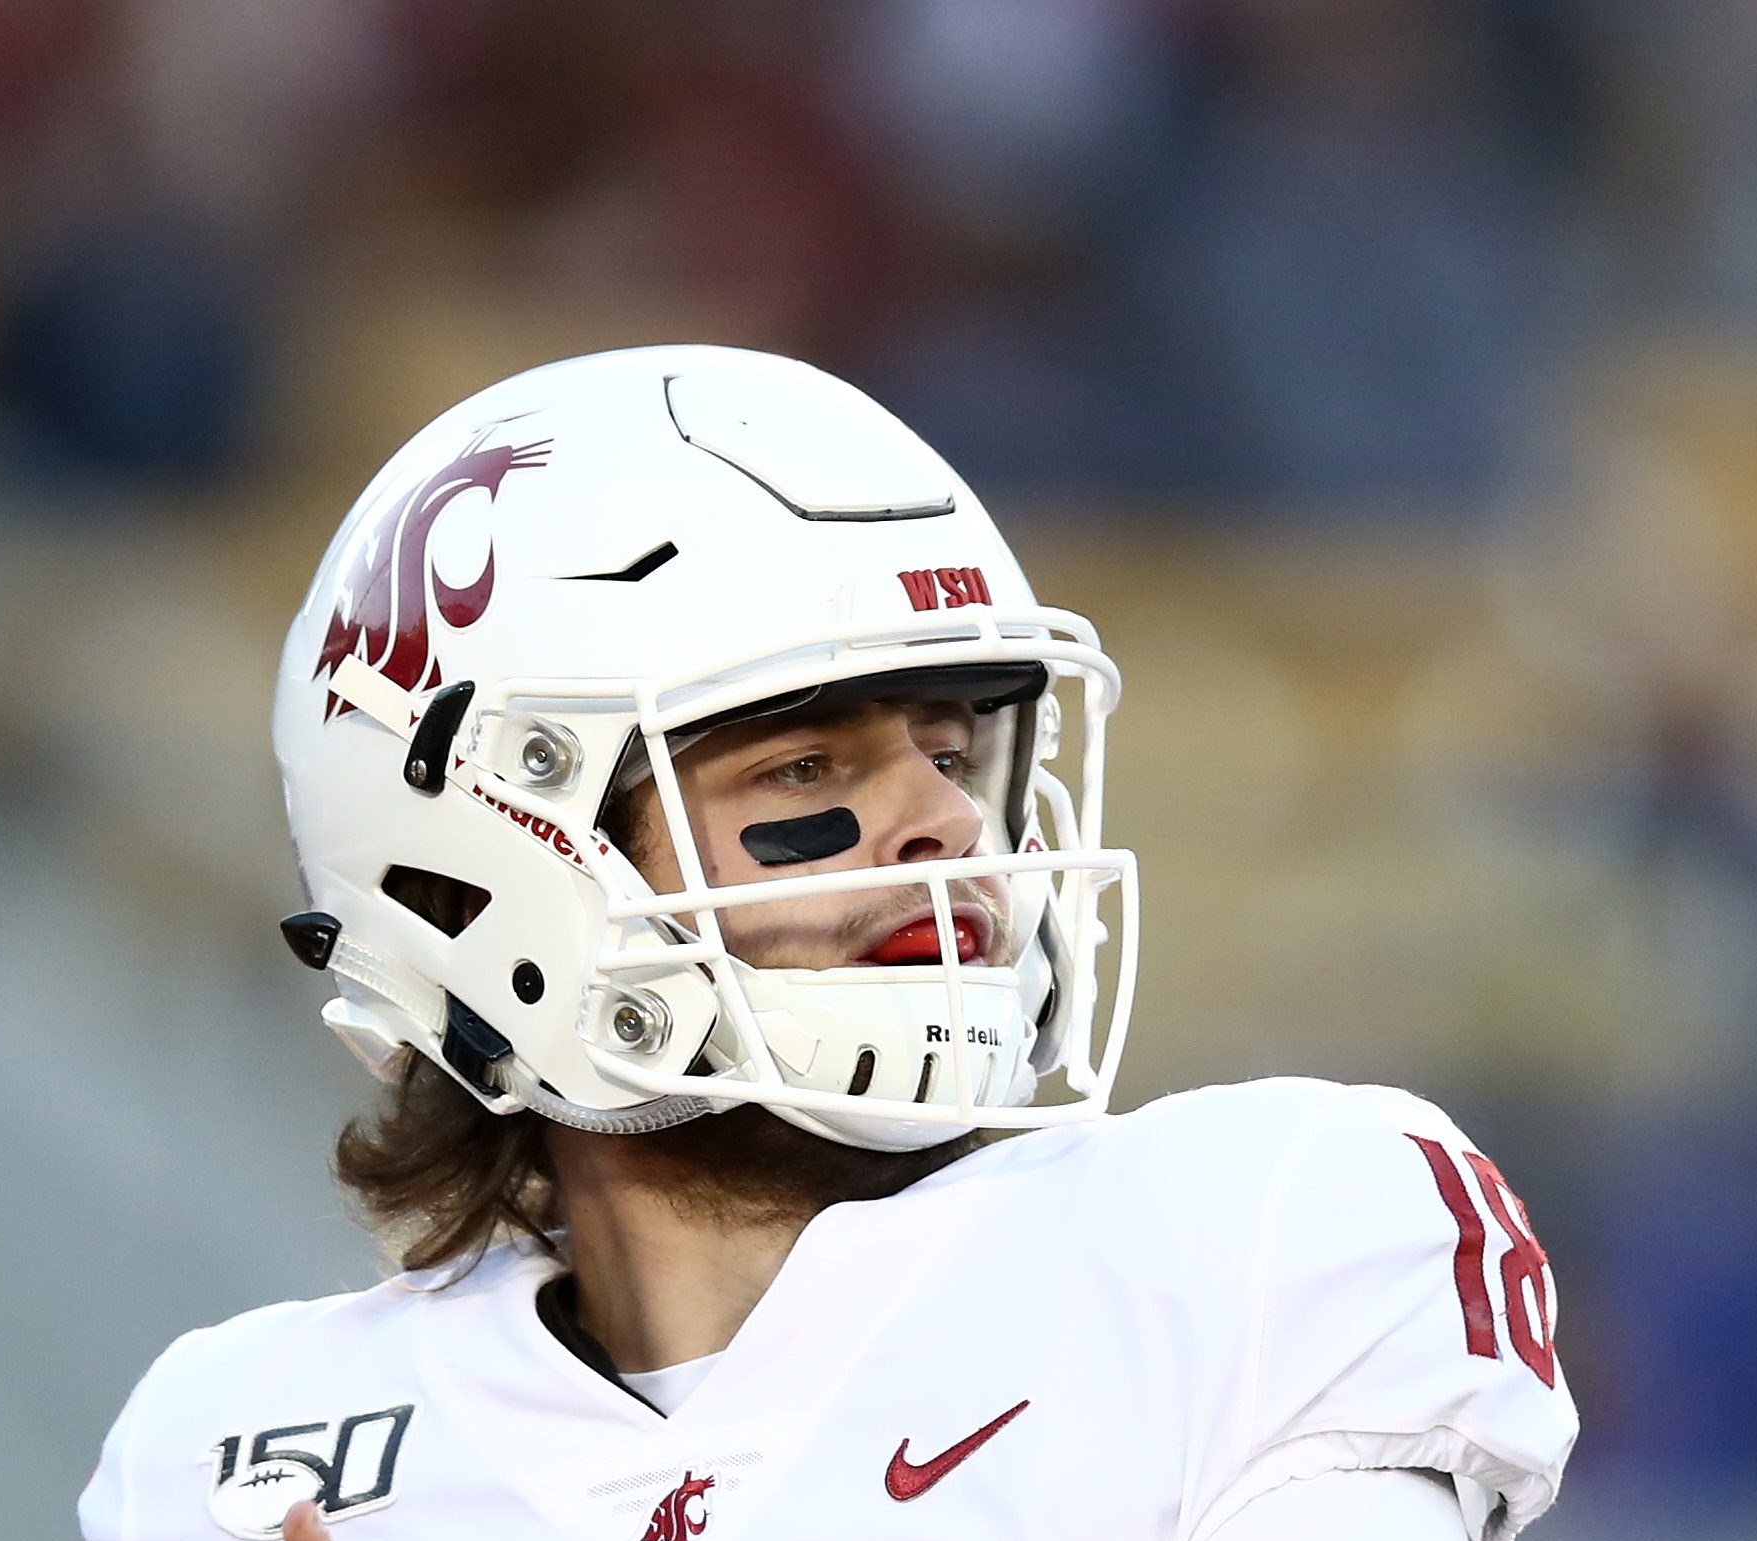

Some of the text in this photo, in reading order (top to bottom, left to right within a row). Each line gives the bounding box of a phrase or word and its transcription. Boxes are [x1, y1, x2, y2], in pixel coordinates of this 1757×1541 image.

[896, 566, 993, 612] WSU
[925, 1024, 1002, 1047] Ridell
[1402, 1131, 1555, 1391] 18
[217, 1403, 416, 1514] 150
